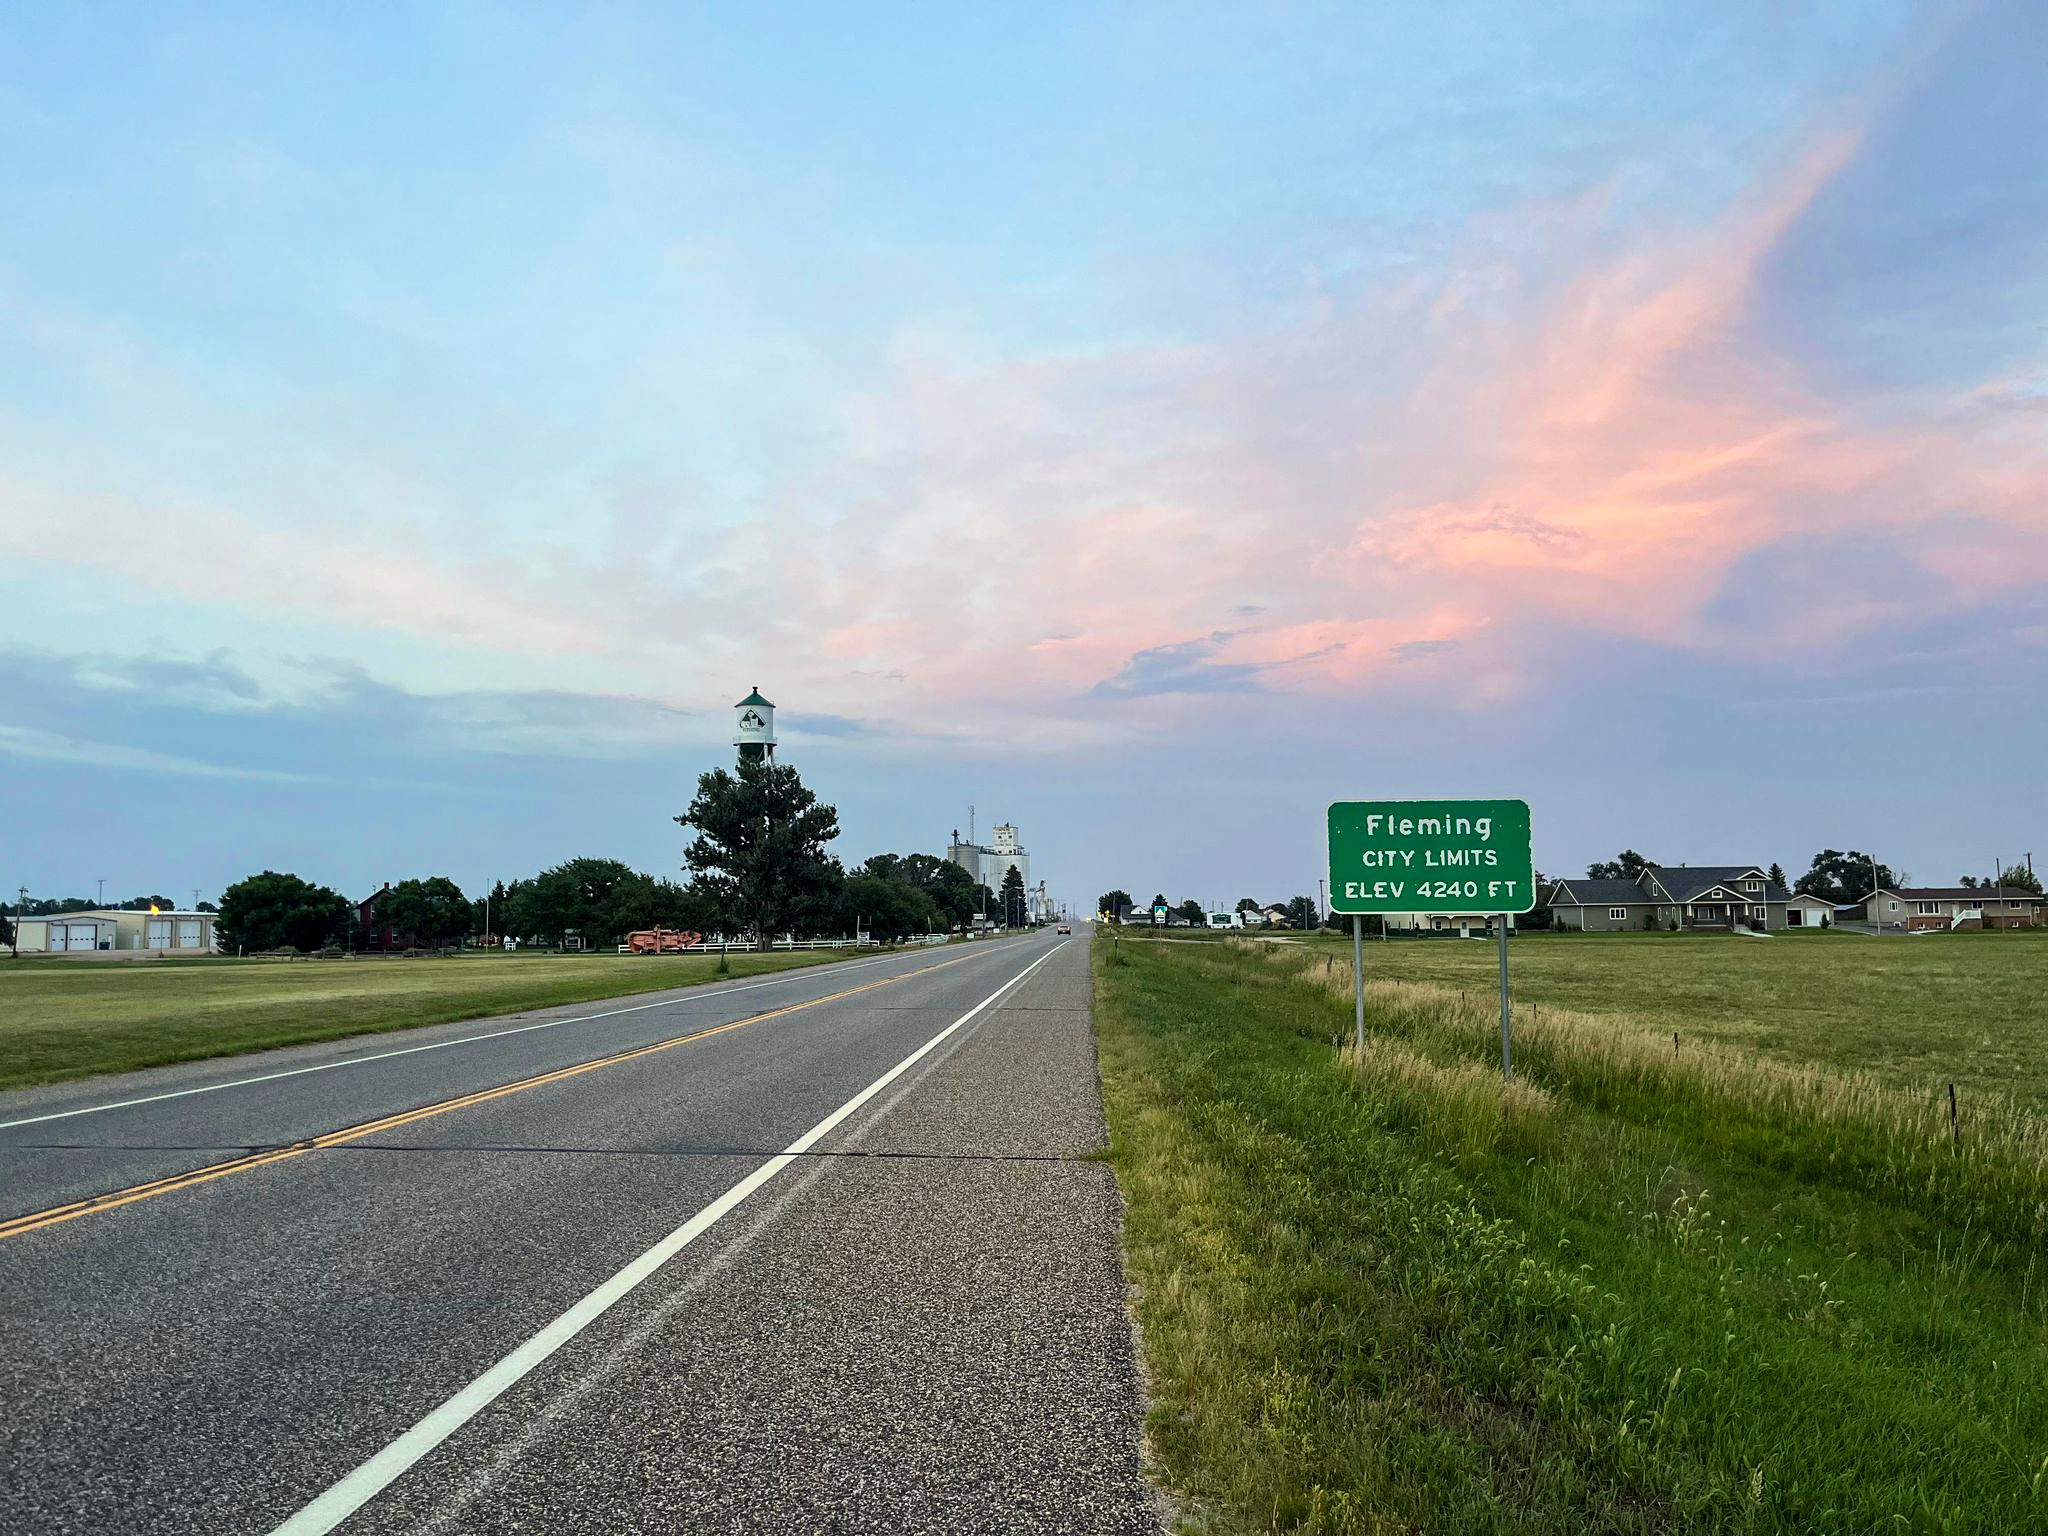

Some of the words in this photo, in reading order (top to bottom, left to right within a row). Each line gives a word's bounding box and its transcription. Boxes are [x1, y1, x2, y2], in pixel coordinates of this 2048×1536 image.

[1366, 814, 1492, 841] Fleming
[1363, 850, 1415, 866] CITY
[1425, 849, 1497, 866] LIMITS
[1345, 881, 1405, 898] ELEV
[1416, 881, 1478, 898] 4240
[1488, 881, 1517, 898] FT
